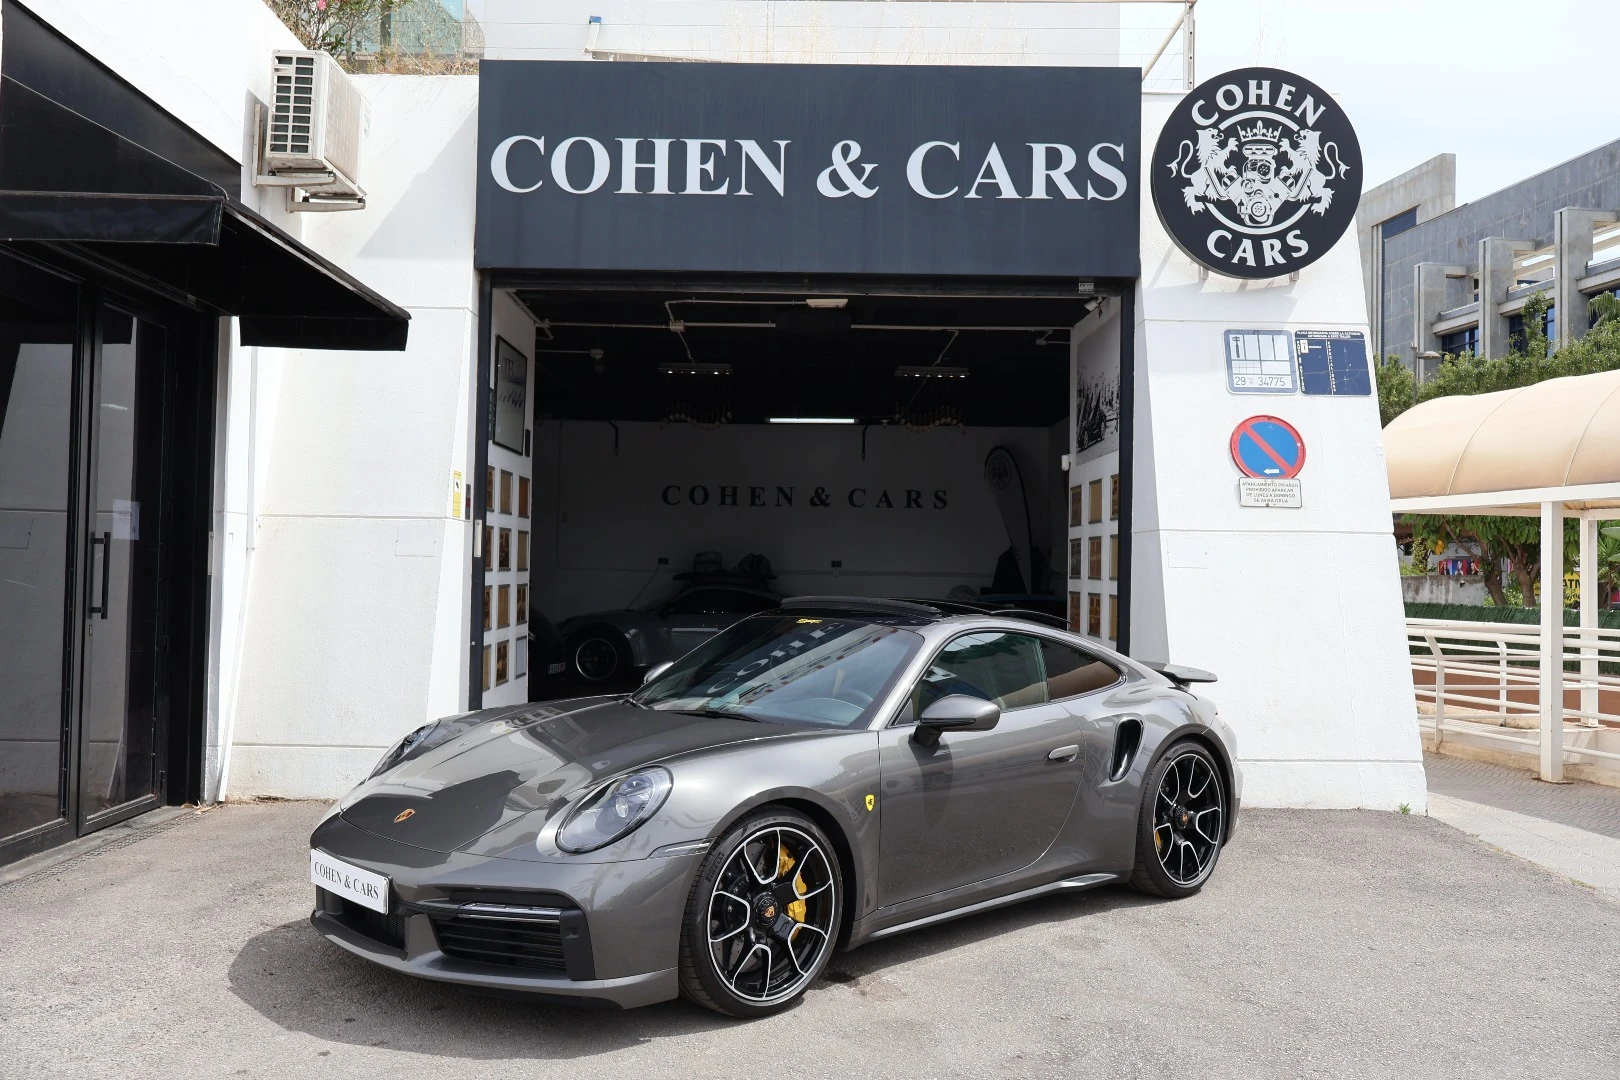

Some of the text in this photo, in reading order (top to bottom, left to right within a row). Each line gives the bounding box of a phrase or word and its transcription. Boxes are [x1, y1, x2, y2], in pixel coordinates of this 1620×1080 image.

[1191, 79, 1327, 127] COHEN
[490, 134, 1129, 202] COHEN & CARS
[1206, 229, 1309, 267] CARS
[1234, 376, 1246, 386] 29
[1257, 376, 1286, 387] 34775
[661, 484, 948, 509] COHEN & CARS
[314, 861, 379, 900] COHEN & CARS
